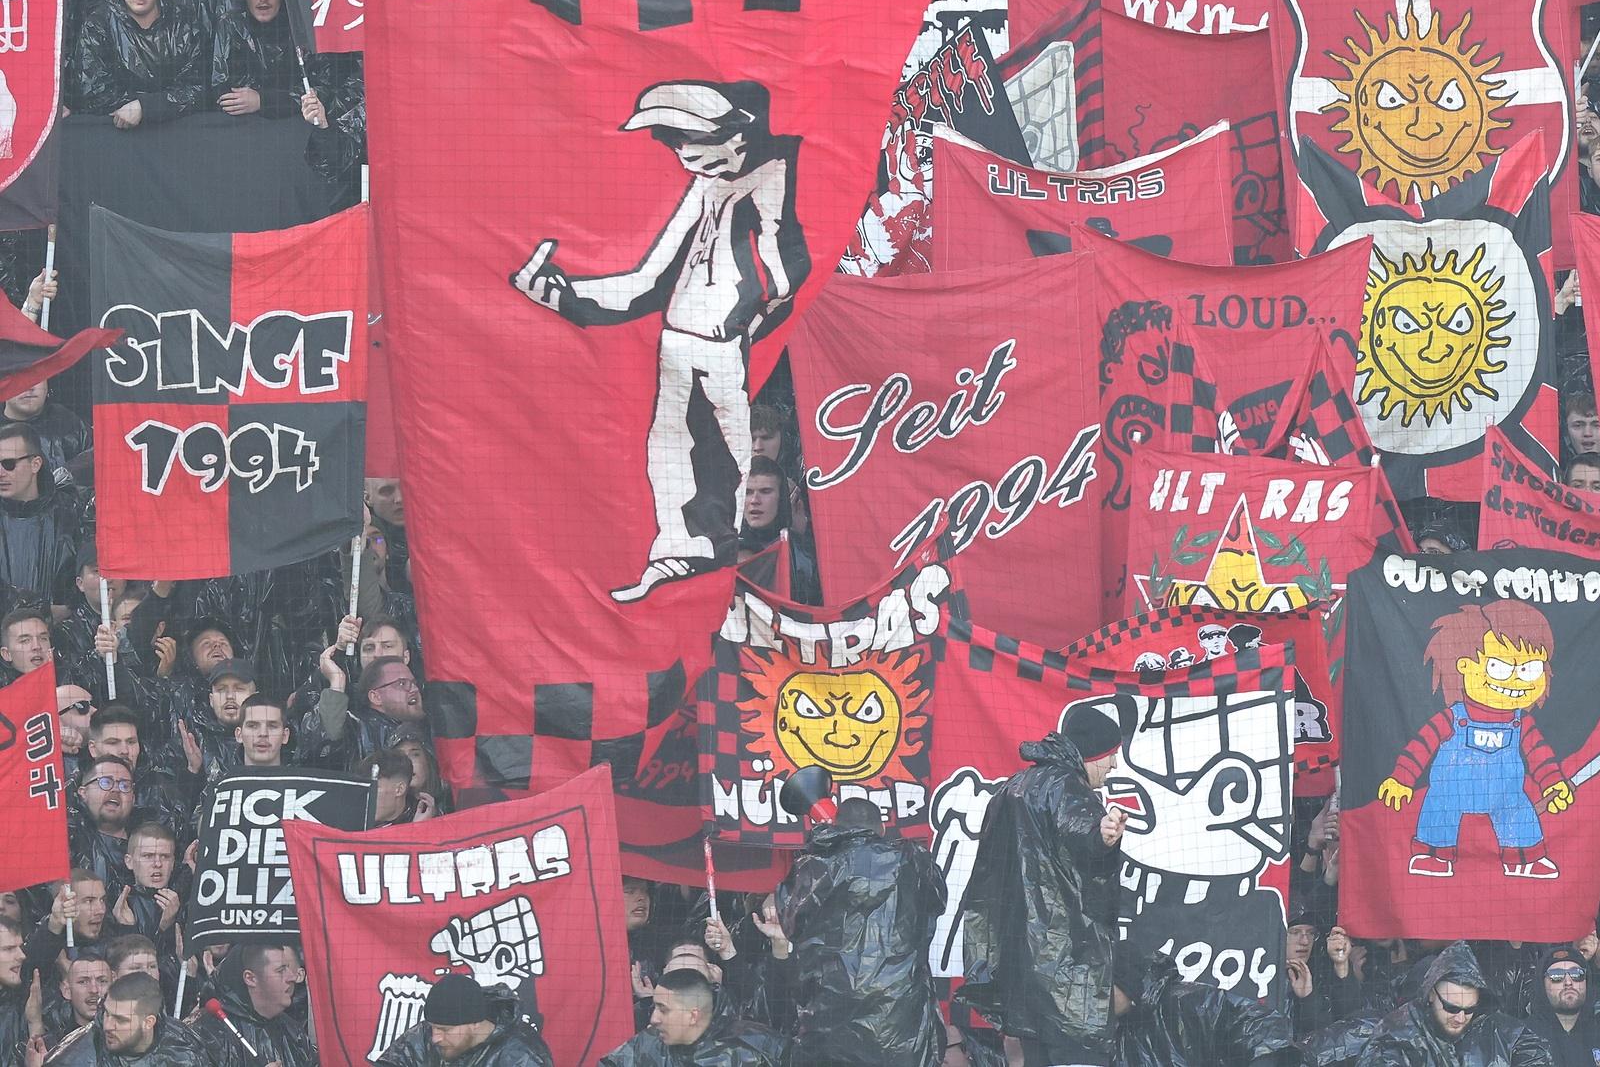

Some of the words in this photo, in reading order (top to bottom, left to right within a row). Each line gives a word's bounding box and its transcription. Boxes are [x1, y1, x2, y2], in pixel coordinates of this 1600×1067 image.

[100, 304, 353, 397] SINCE
[126, 419, 320, 496] 1994
[208, 788, 325, 828] FICK
[216, 828, 290, 866] DIE
[337, 824, 571, 906] ULTRAS
[197, 868, 297, 907] OLIZ
[219, 909, 283, 926] UN94
